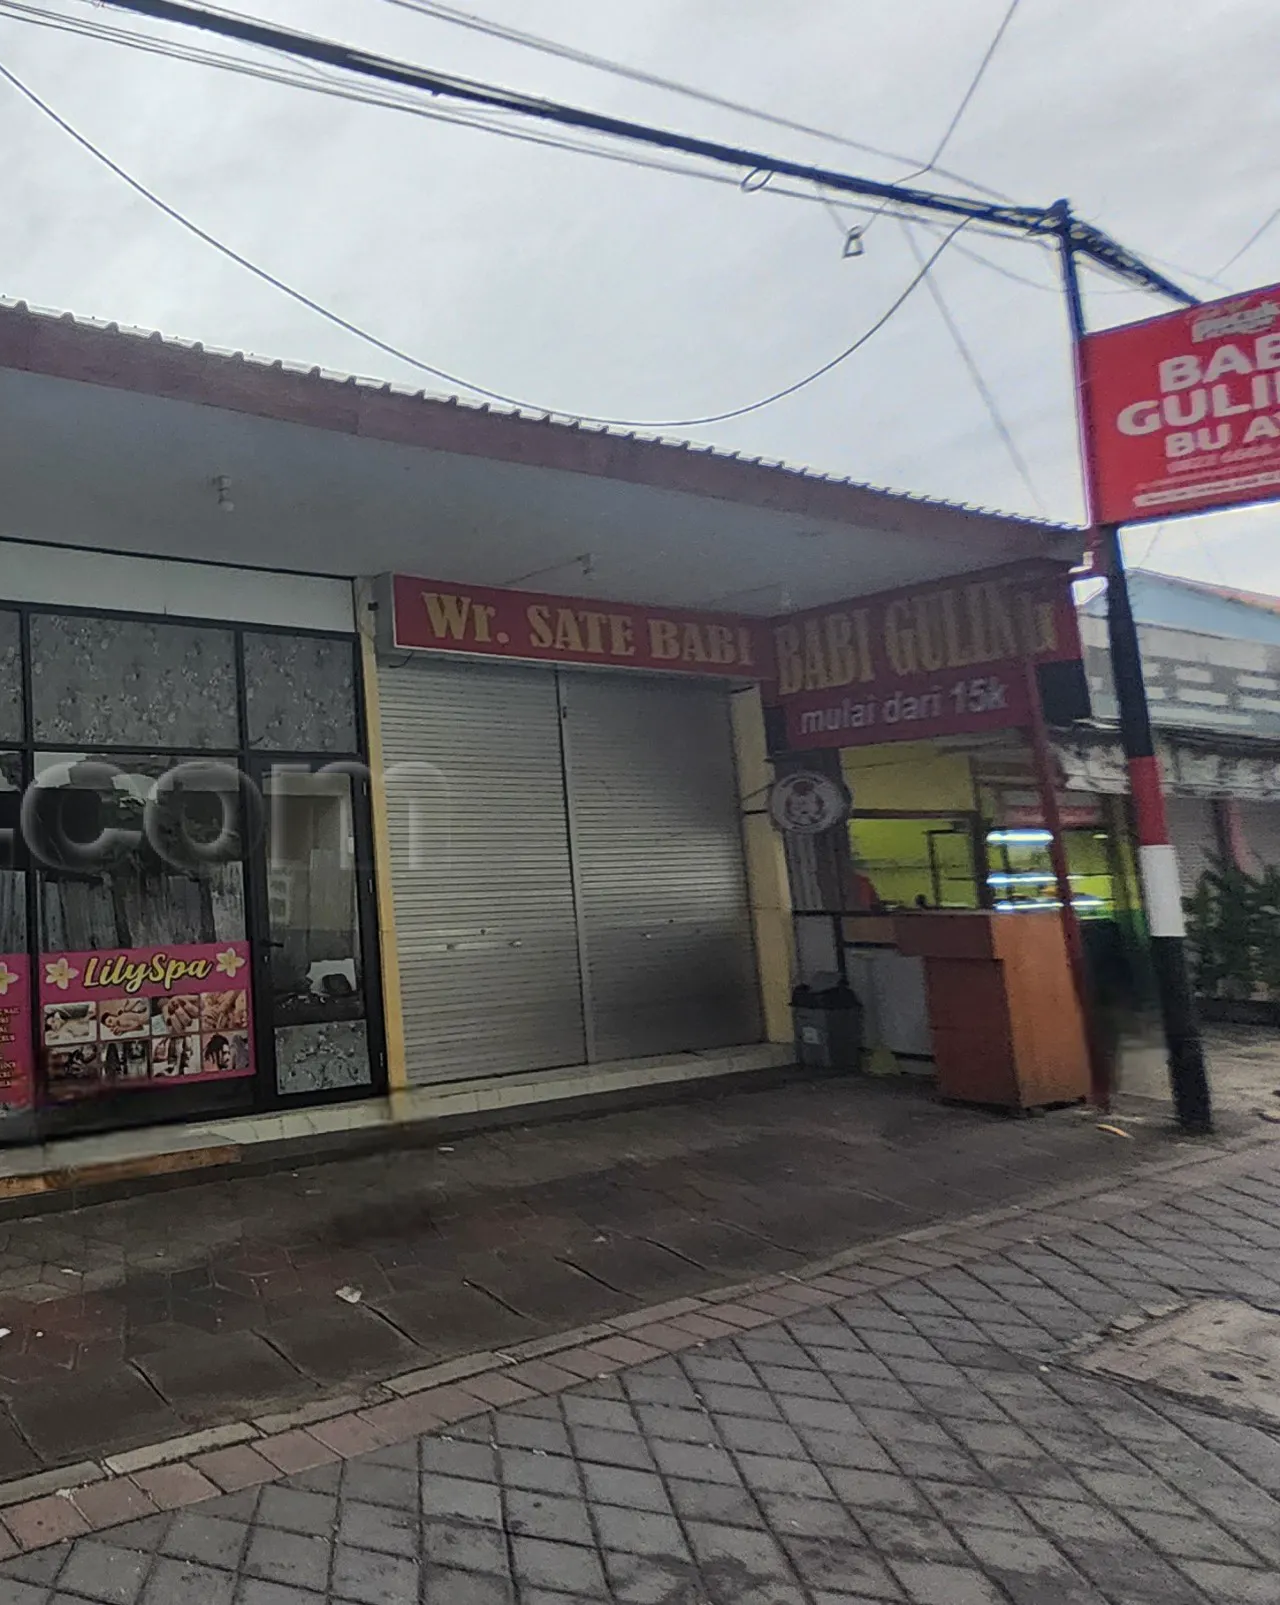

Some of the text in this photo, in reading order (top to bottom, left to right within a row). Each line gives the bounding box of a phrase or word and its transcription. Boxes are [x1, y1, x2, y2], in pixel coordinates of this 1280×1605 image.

[1116, 373, 1280, 436] GULI
[1165, 423, 1231, 458] BU
[421, 591, 755, 667] Wr. SATE BABI
[773, 608, 876, 695] BABI
[800, 675, 1008, 735] mulai dari 15k
